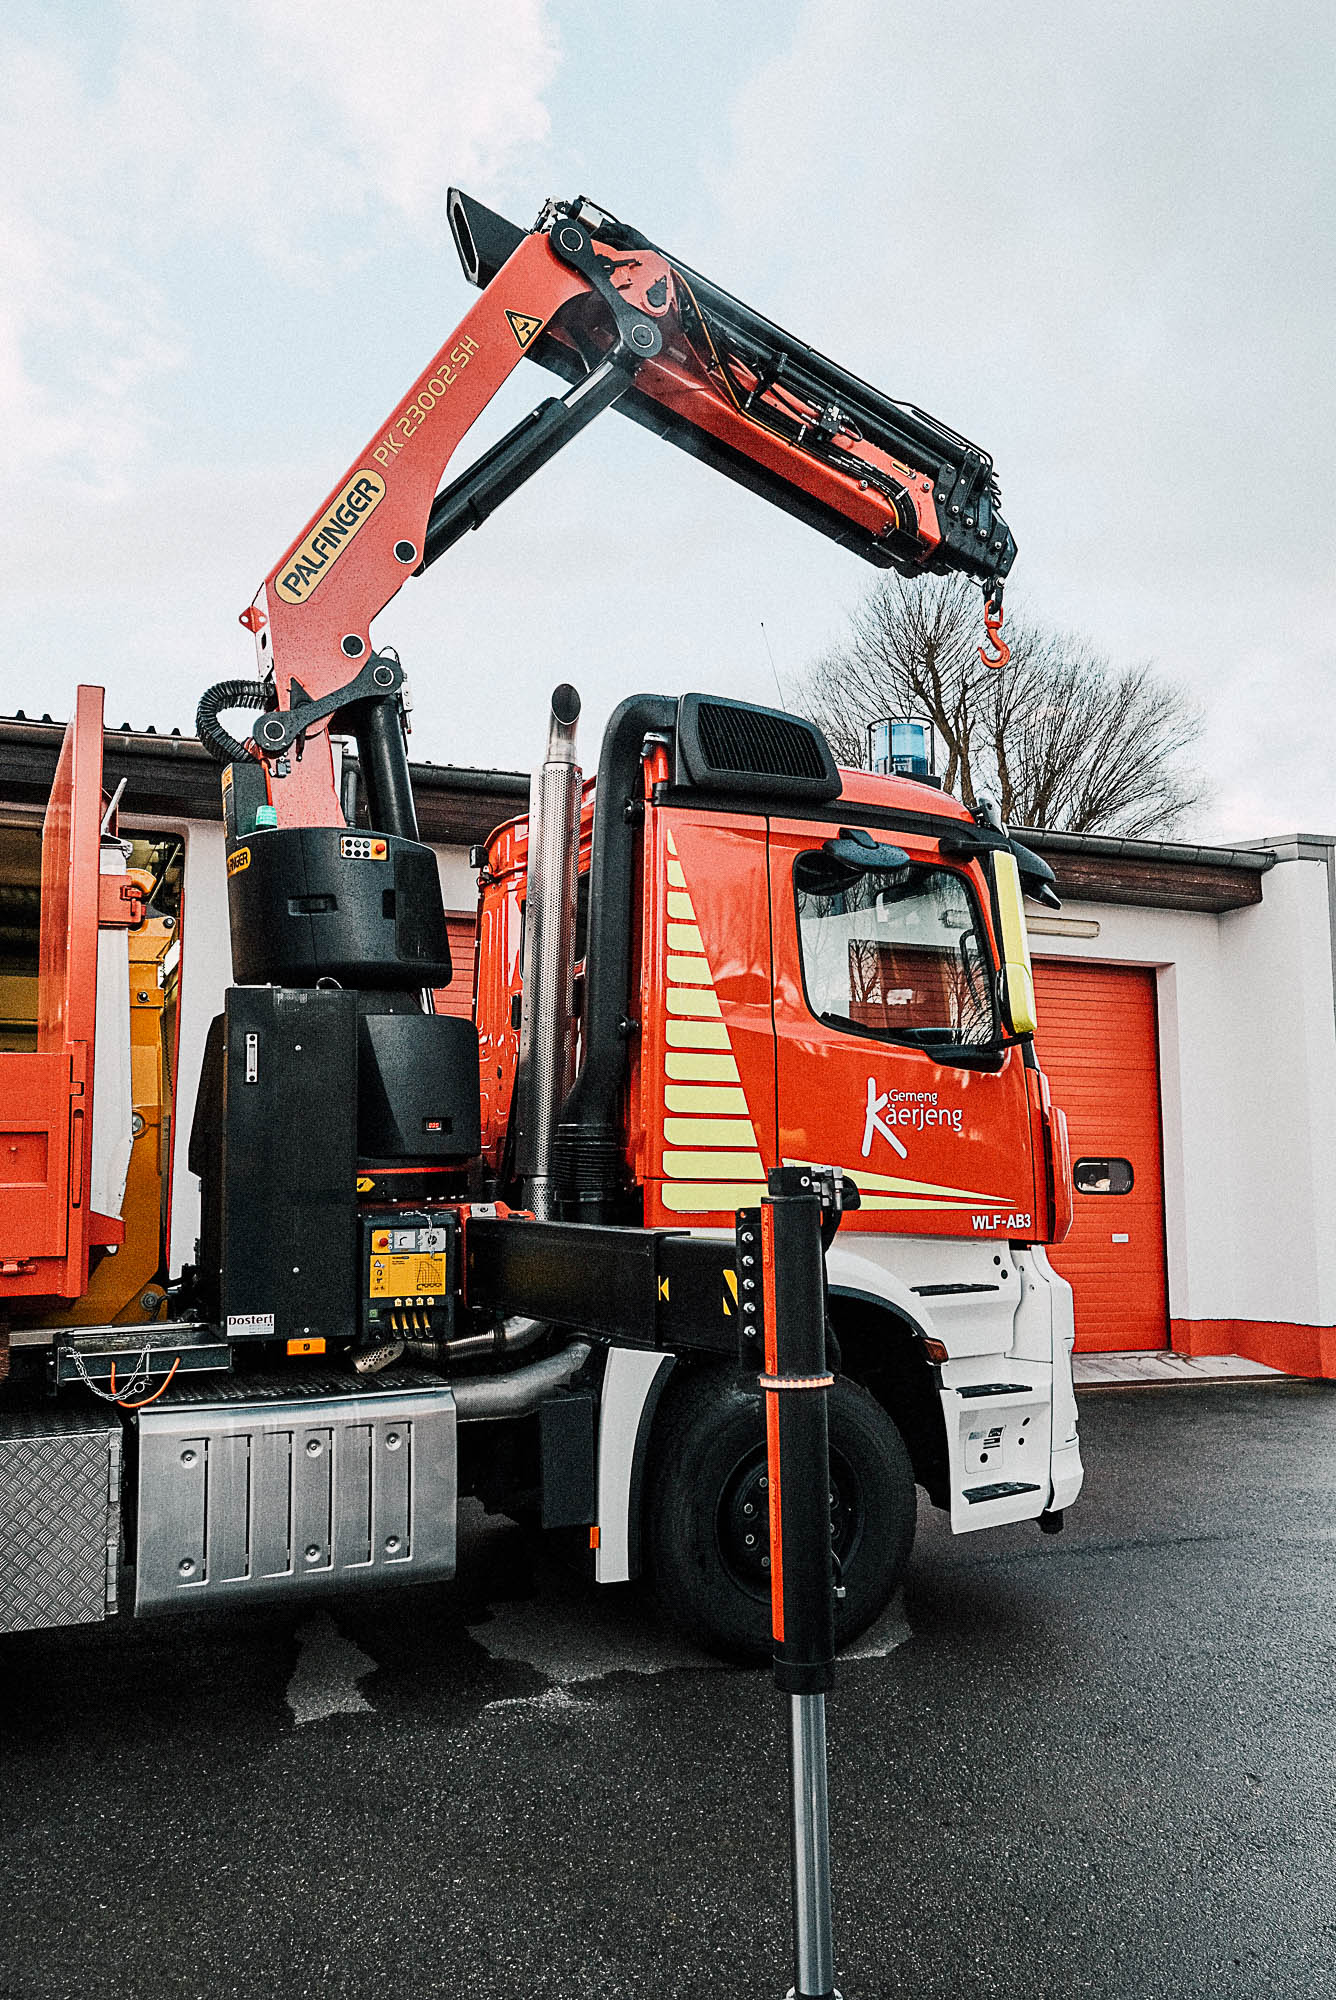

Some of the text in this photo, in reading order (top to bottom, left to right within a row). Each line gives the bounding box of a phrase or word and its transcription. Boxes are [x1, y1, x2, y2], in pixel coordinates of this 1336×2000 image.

[372, 432, 405, 467] PK
[281, 478, 380, 597] PALFINGER
[888, 1088, 938, 1106] Gemeng
[861, 1077, 963, 1159] Käerjeng
[971, 1213, 1031, 1230] WLF-AB3
[228, 1315, 273, 1326] Dostert
